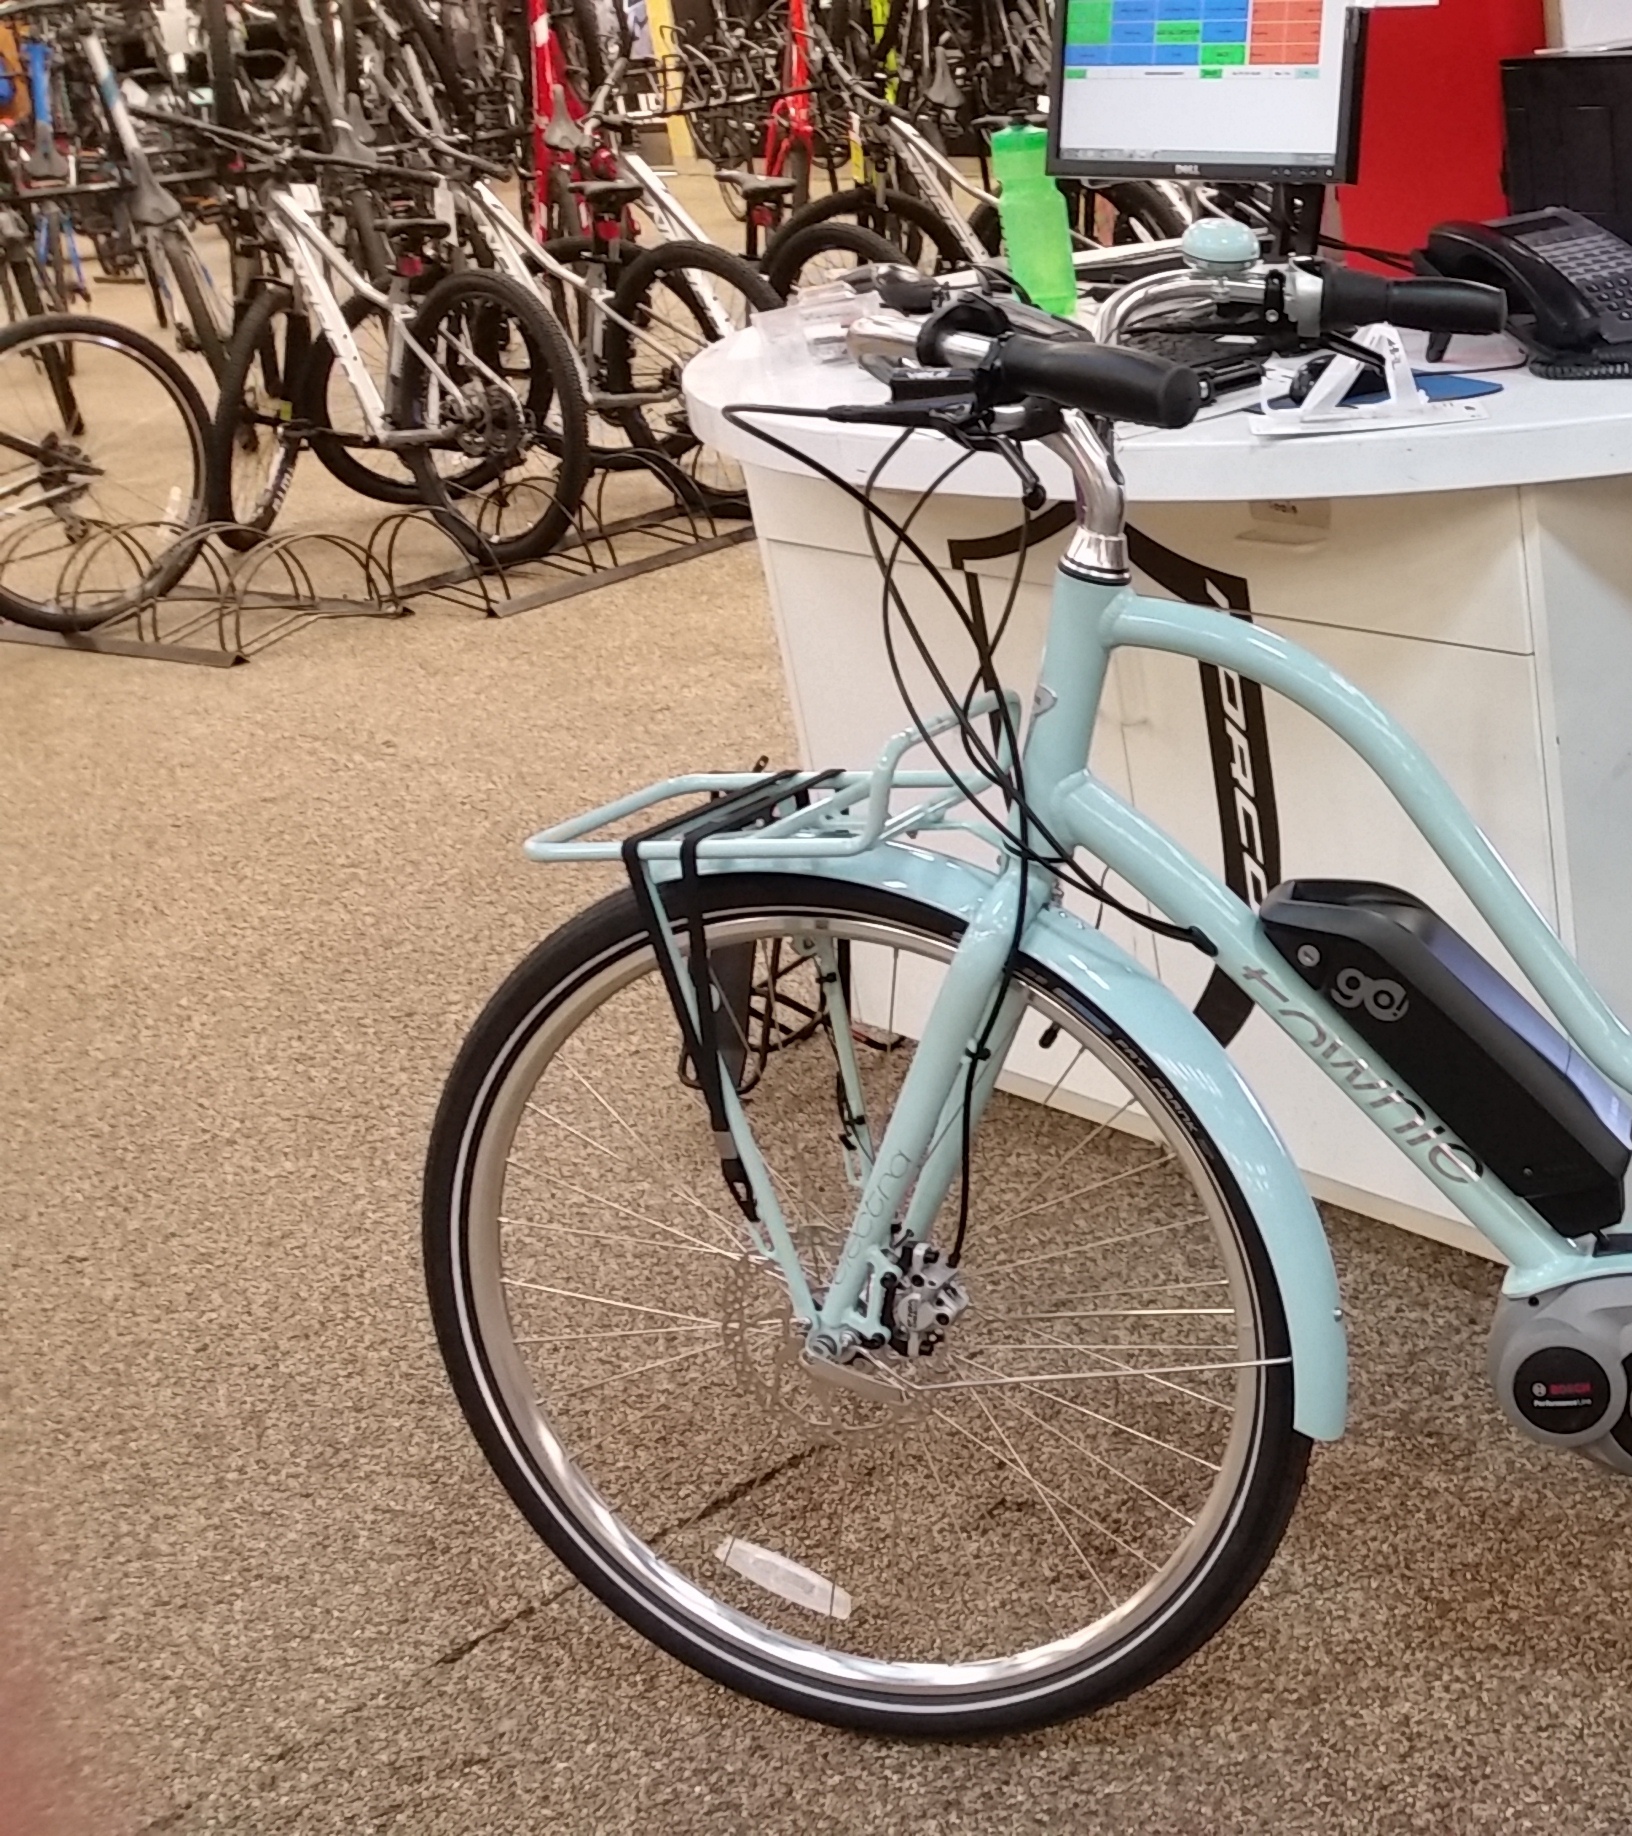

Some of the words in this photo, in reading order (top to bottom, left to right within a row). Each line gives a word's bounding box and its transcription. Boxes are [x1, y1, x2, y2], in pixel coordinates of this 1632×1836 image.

[1330, 967, 1409, 1021] go!
[1115, 1039, 1148, 1069] FAT
[1151, 1077, 1198, 1132] FRANK
[1242, 966, 1483, 1184] townie
